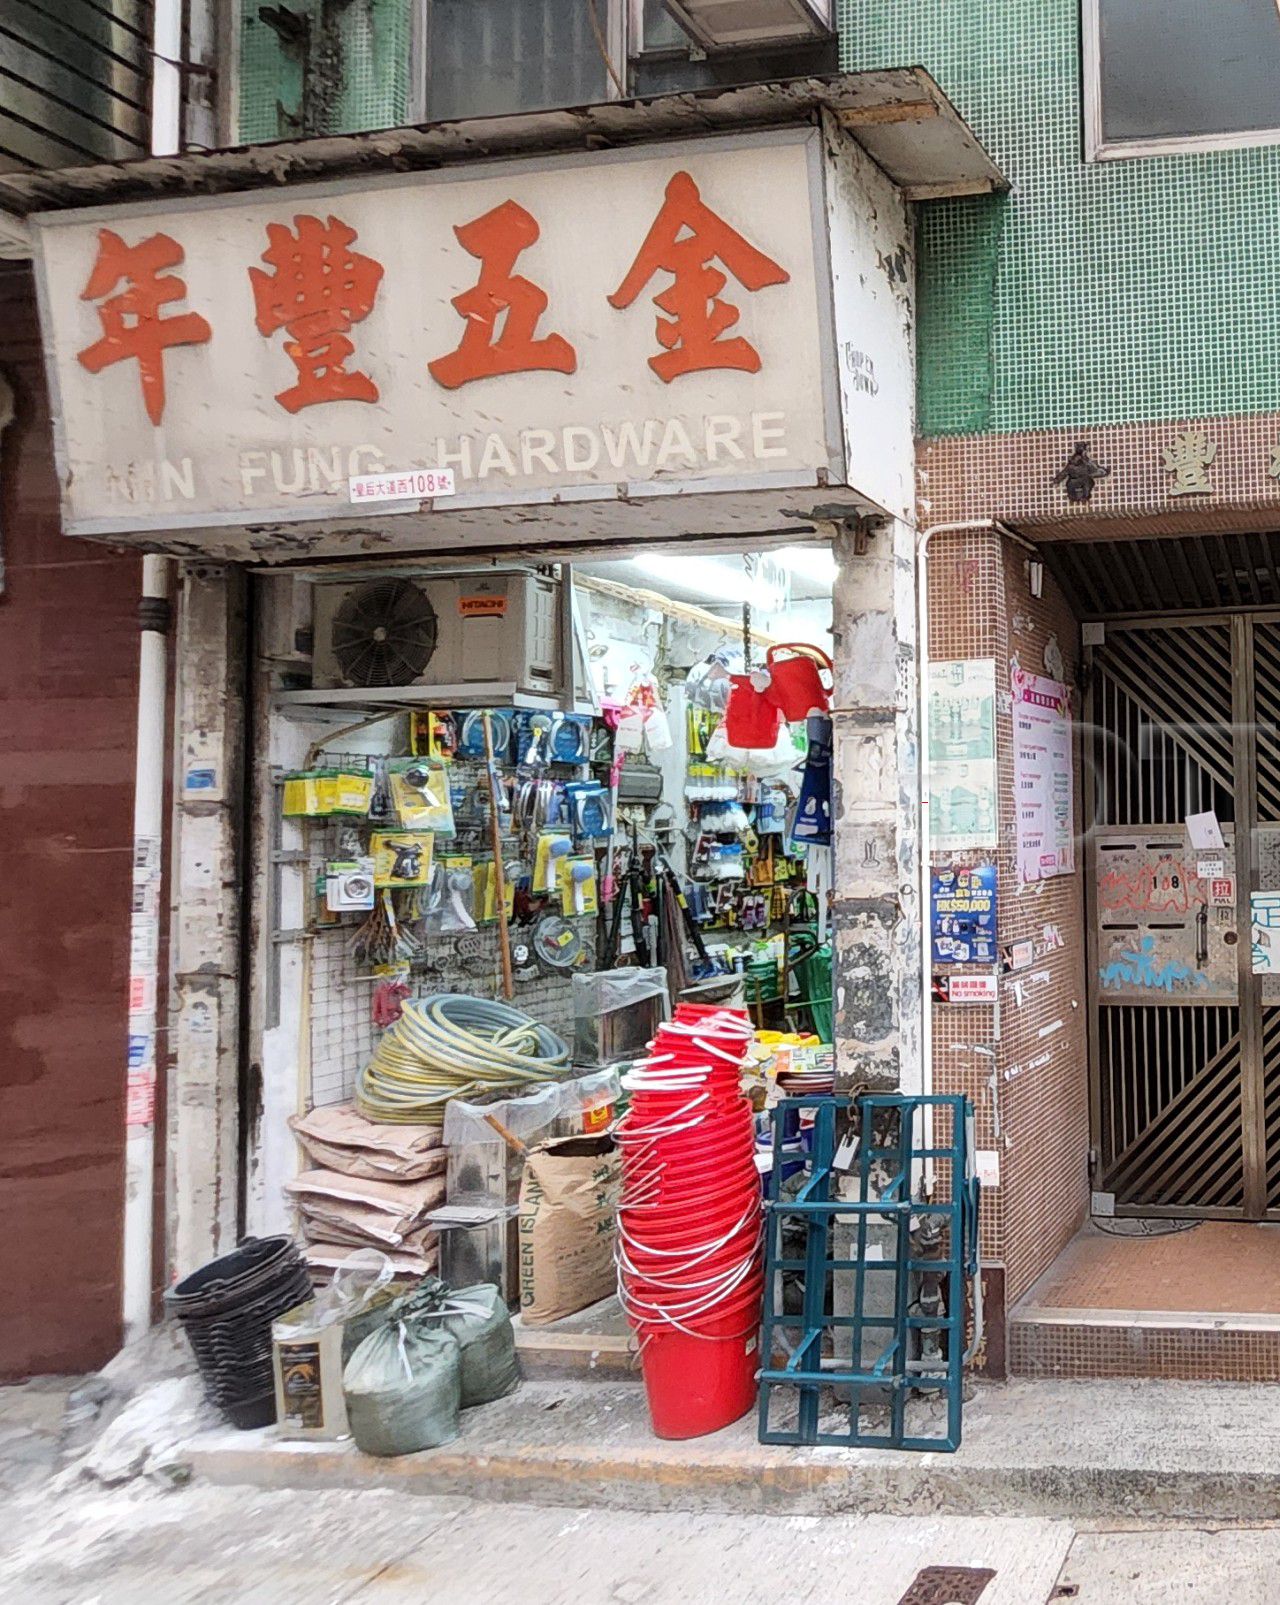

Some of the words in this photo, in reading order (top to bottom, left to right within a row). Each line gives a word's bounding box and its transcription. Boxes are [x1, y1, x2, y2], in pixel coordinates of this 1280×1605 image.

[77, 170, 791, 426] 年豐五金
[240, 444, 386, 495] FUNG
[437, 411, 788, 479] HARDWARE
[1213, 881, 1231, 896] 拉
[521, 1243, 535, 1308] GREEN
